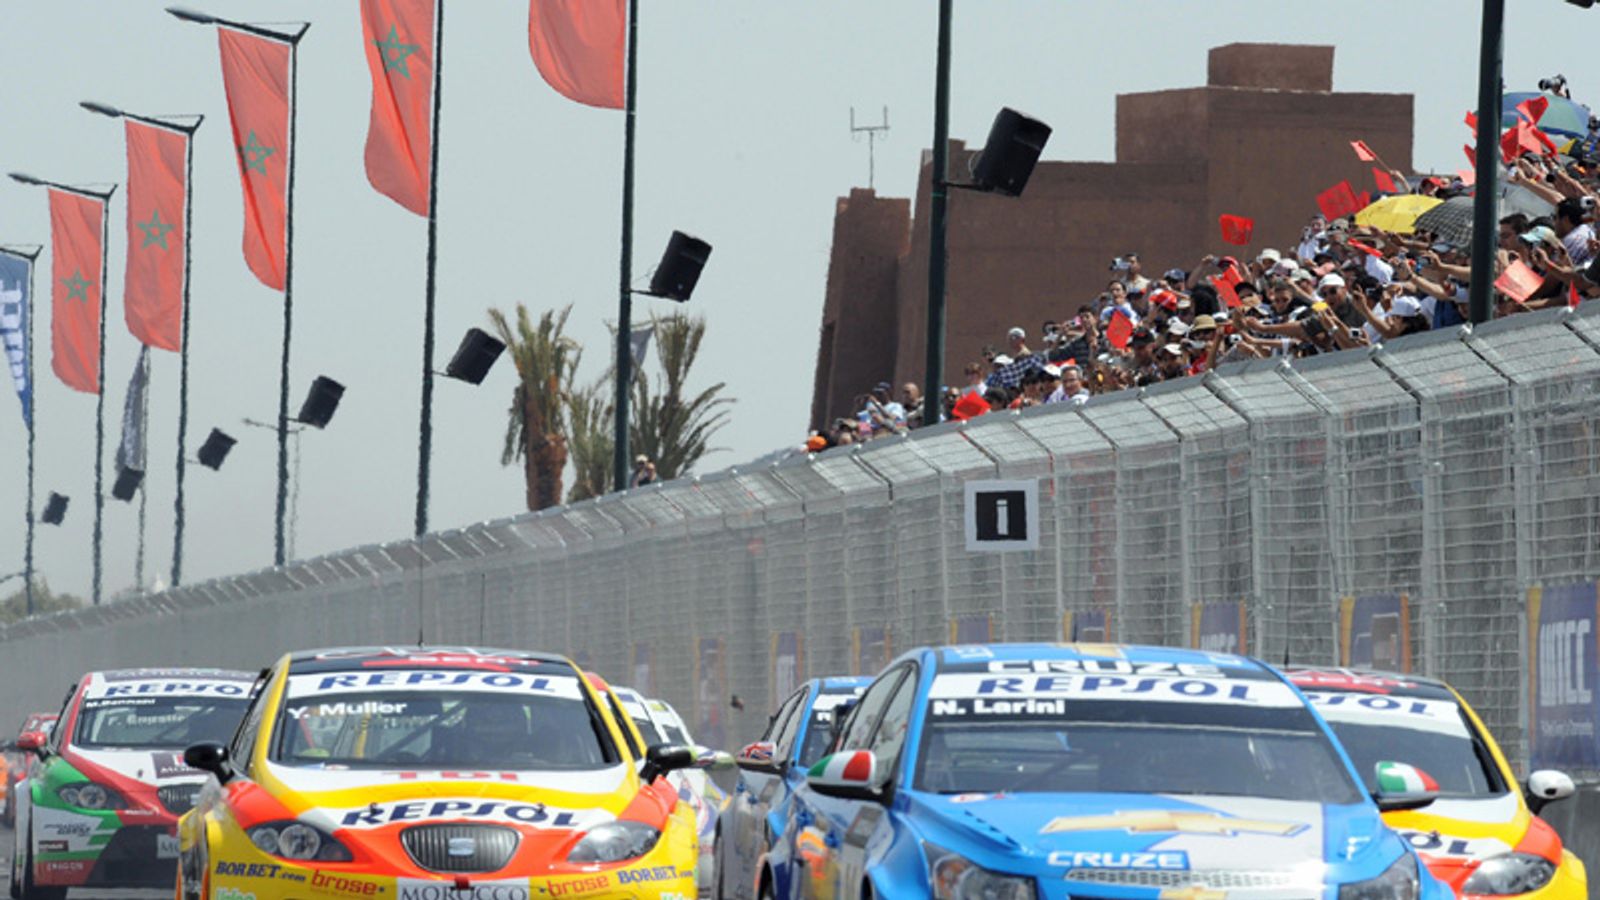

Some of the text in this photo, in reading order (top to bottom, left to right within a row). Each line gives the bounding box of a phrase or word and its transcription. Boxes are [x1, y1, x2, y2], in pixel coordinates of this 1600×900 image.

[988, 660, 1226, 678] CRUZE
[105, 681, 258, 698] REPSO
[318, 672, 555, 692] REPSOL
[977, 676, 1259, 702] REPSOL
[287, 701, 408, 720] Y. Muller
[933, 698, 1065, 716] N. Larini
[341, 801, 583, 827] REPSOL
[1047, 850, 1185, 869] CRUZE
[311, 869, 378, 895] brose
[546, 875, 610, 897] brose
[401, 885, 528, 900] MOROCCO
